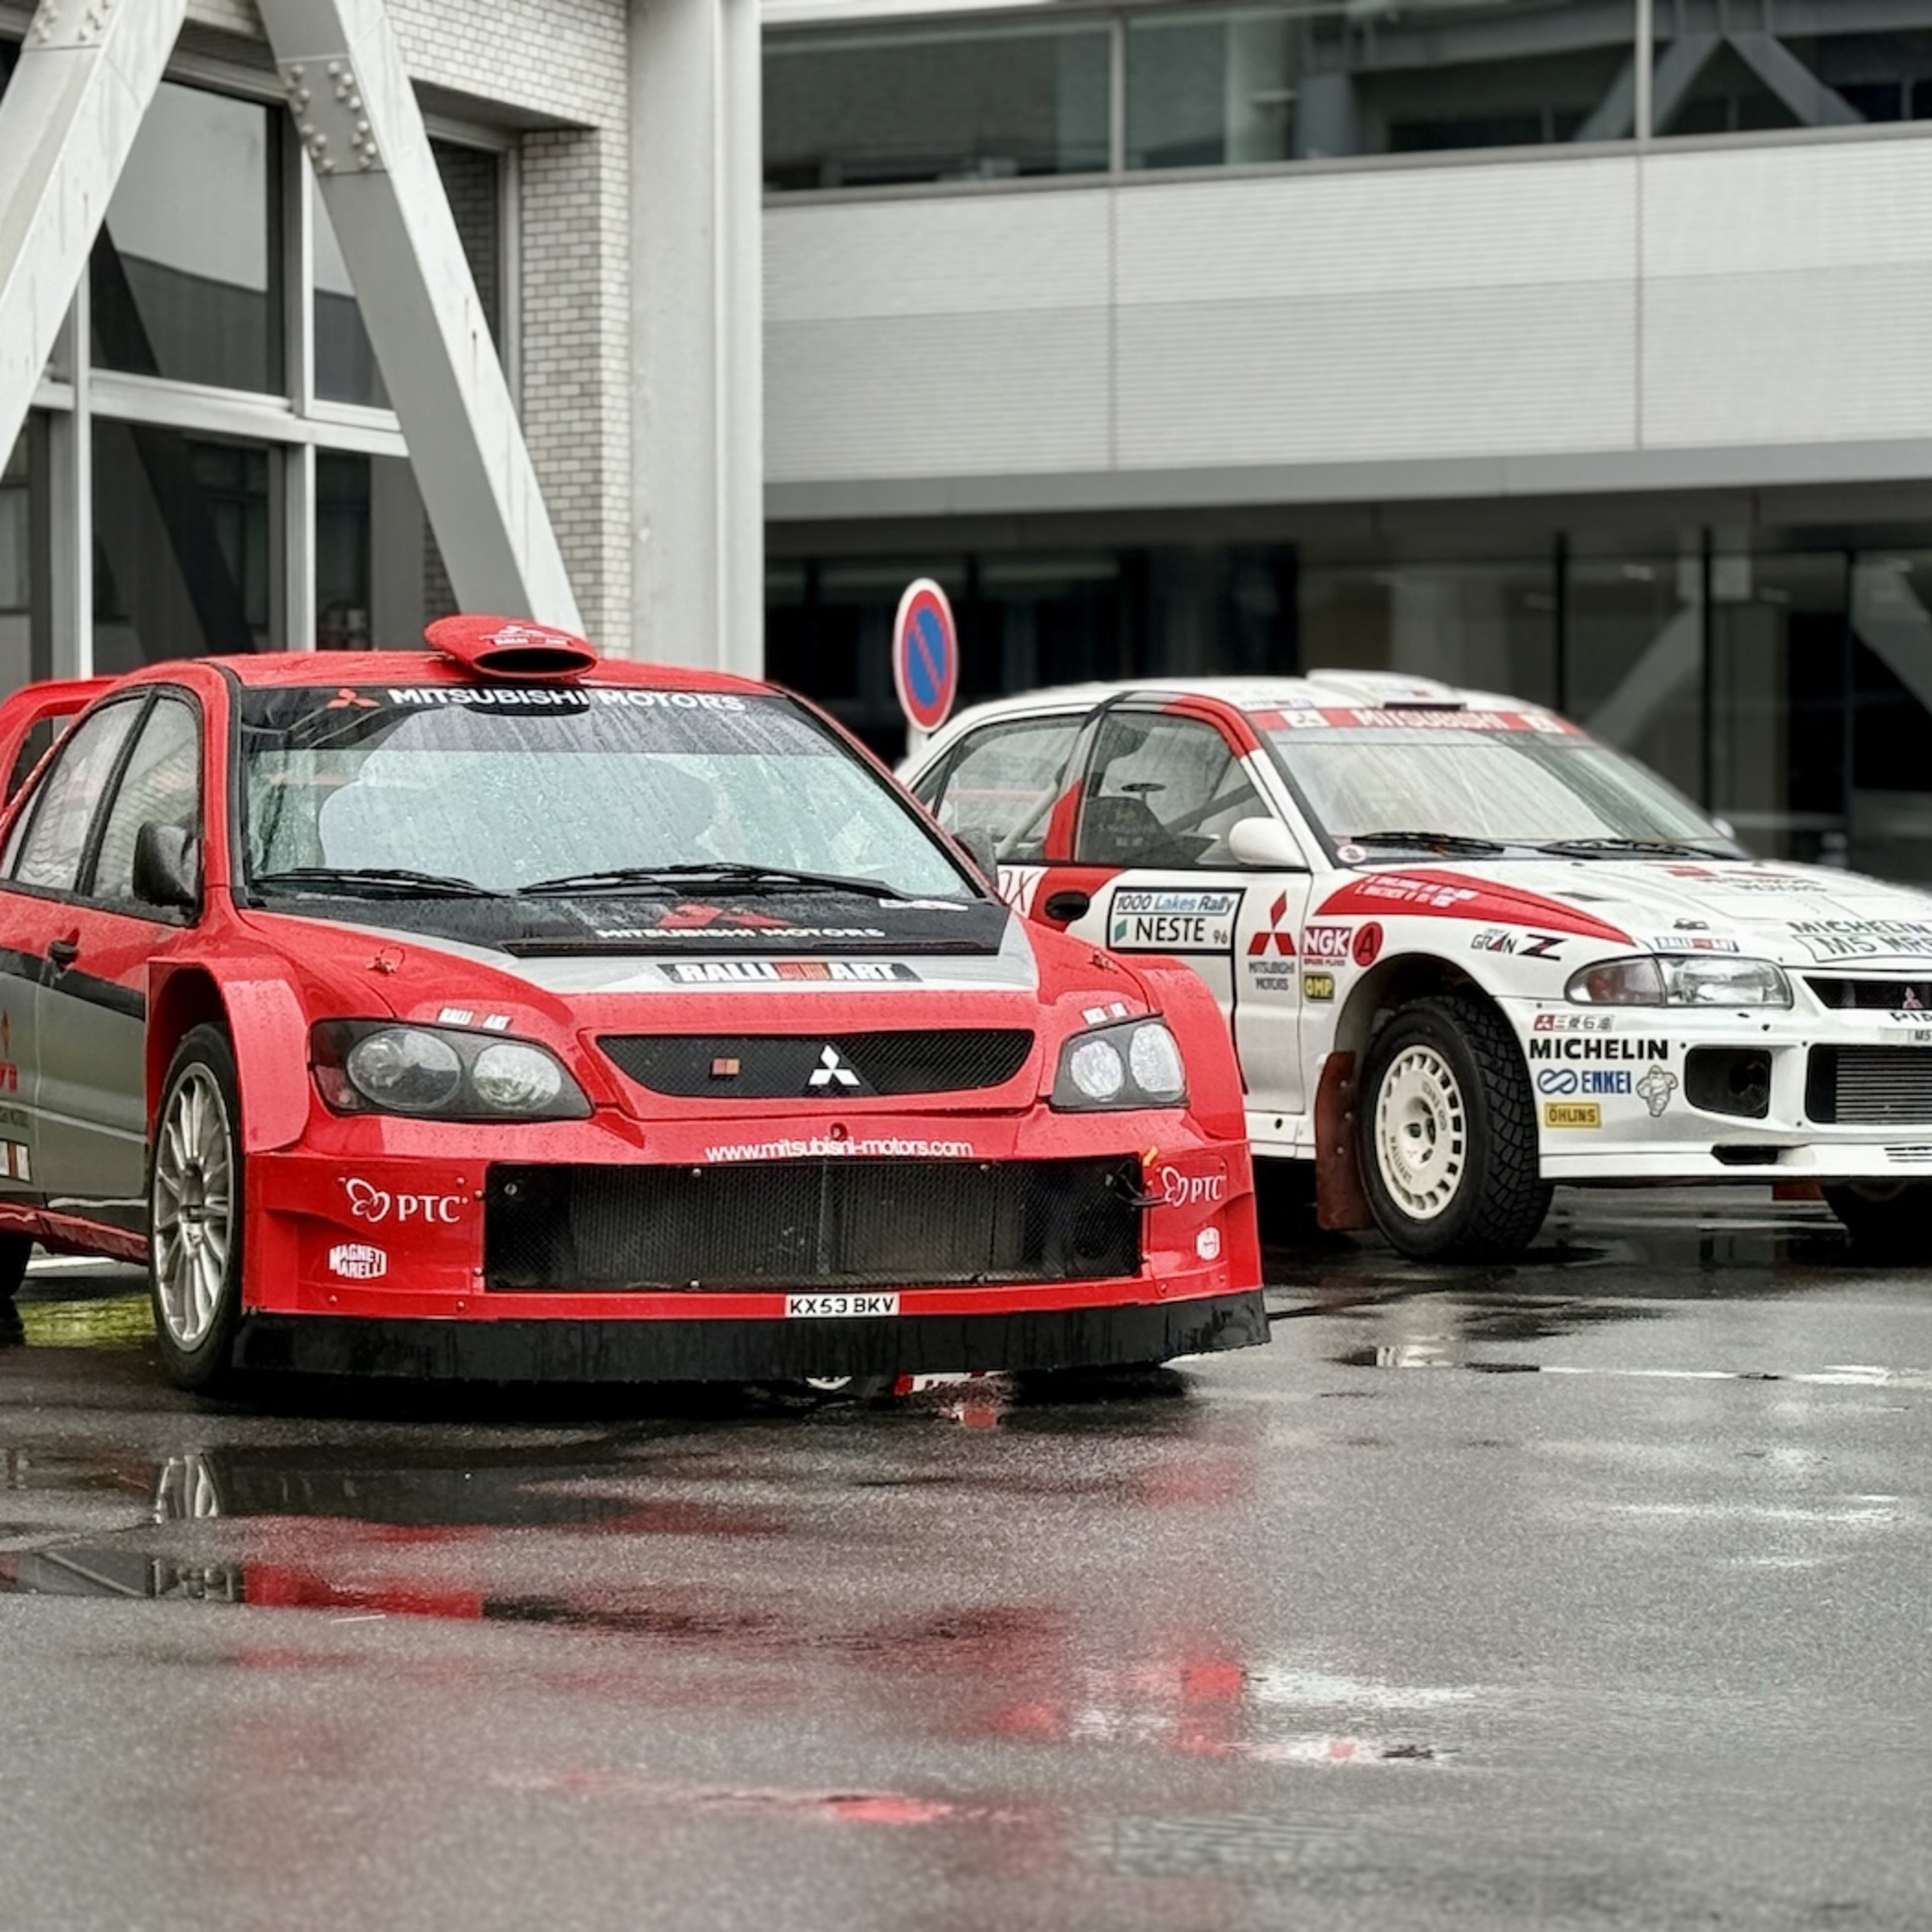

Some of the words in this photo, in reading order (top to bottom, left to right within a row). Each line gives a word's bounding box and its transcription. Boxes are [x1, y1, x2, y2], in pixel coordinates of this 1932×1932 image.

[387, 688, 589, 704] MITSUBISHI
[596, 690, 746, 711] MOTORS
[1351, 709, 1509, 730] MITSUBISHI
[1116, 895, 1152, 910] 1000
[1153, 895, 1196, 911] Lakes
[1197, 895, 1236, 911] Rally
[1136, 917, 1205, 942] NESTE
[1213, 930, 1228, 944] 96
[1786, 921, 1931, 933] MICHELIN
[1303, 929, 1350, 955] NGK
[1358, 927, 1375, 957] A
[1516, 934, 1569, 961] Z
[674, 962, 783, 982] RALLI
[827, 962, 898, 981] ART
[1305, 977, 1334, 997] OMP
[1530, 1038, 1668, 1060] MICHELIN
[1582, 1070, 1632, 1094] ENKEI
[705, 1136, 974, 1162] www.mitsubishi-motors.com
[1191, 1176, 1223, 1203] PTC
[396, 1194, 460, 1223] PTC
[789, 1298, 847, 1315] KX53
[854, 1297, 896, 1314] BKV
